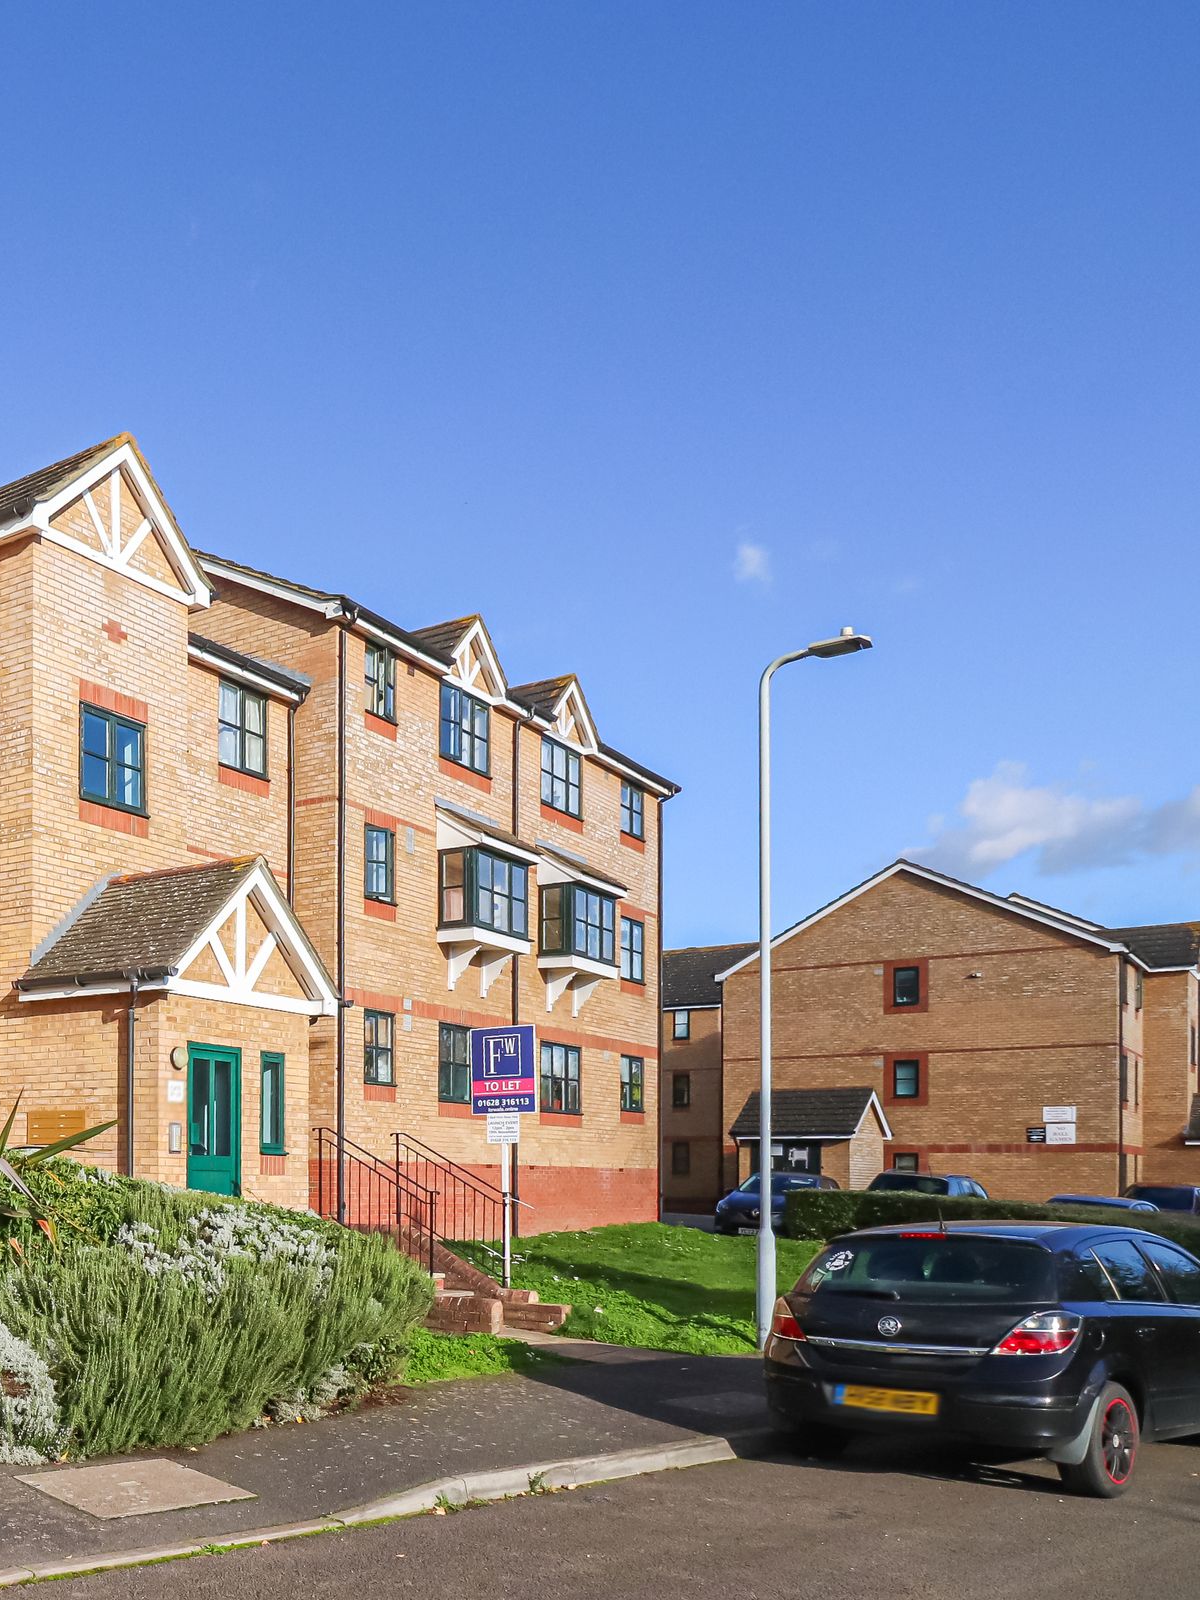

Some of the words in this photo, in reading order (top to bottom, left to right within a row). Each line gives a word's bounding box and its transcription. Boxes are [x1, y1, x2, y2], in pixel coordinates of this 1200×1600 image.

[484, 1081, 499, 1091] TO
[502, 1080, 521, 1090] LET
[477, 1099, 500, 1107] 01628
[501, 1098, 529, 1106] 316113
